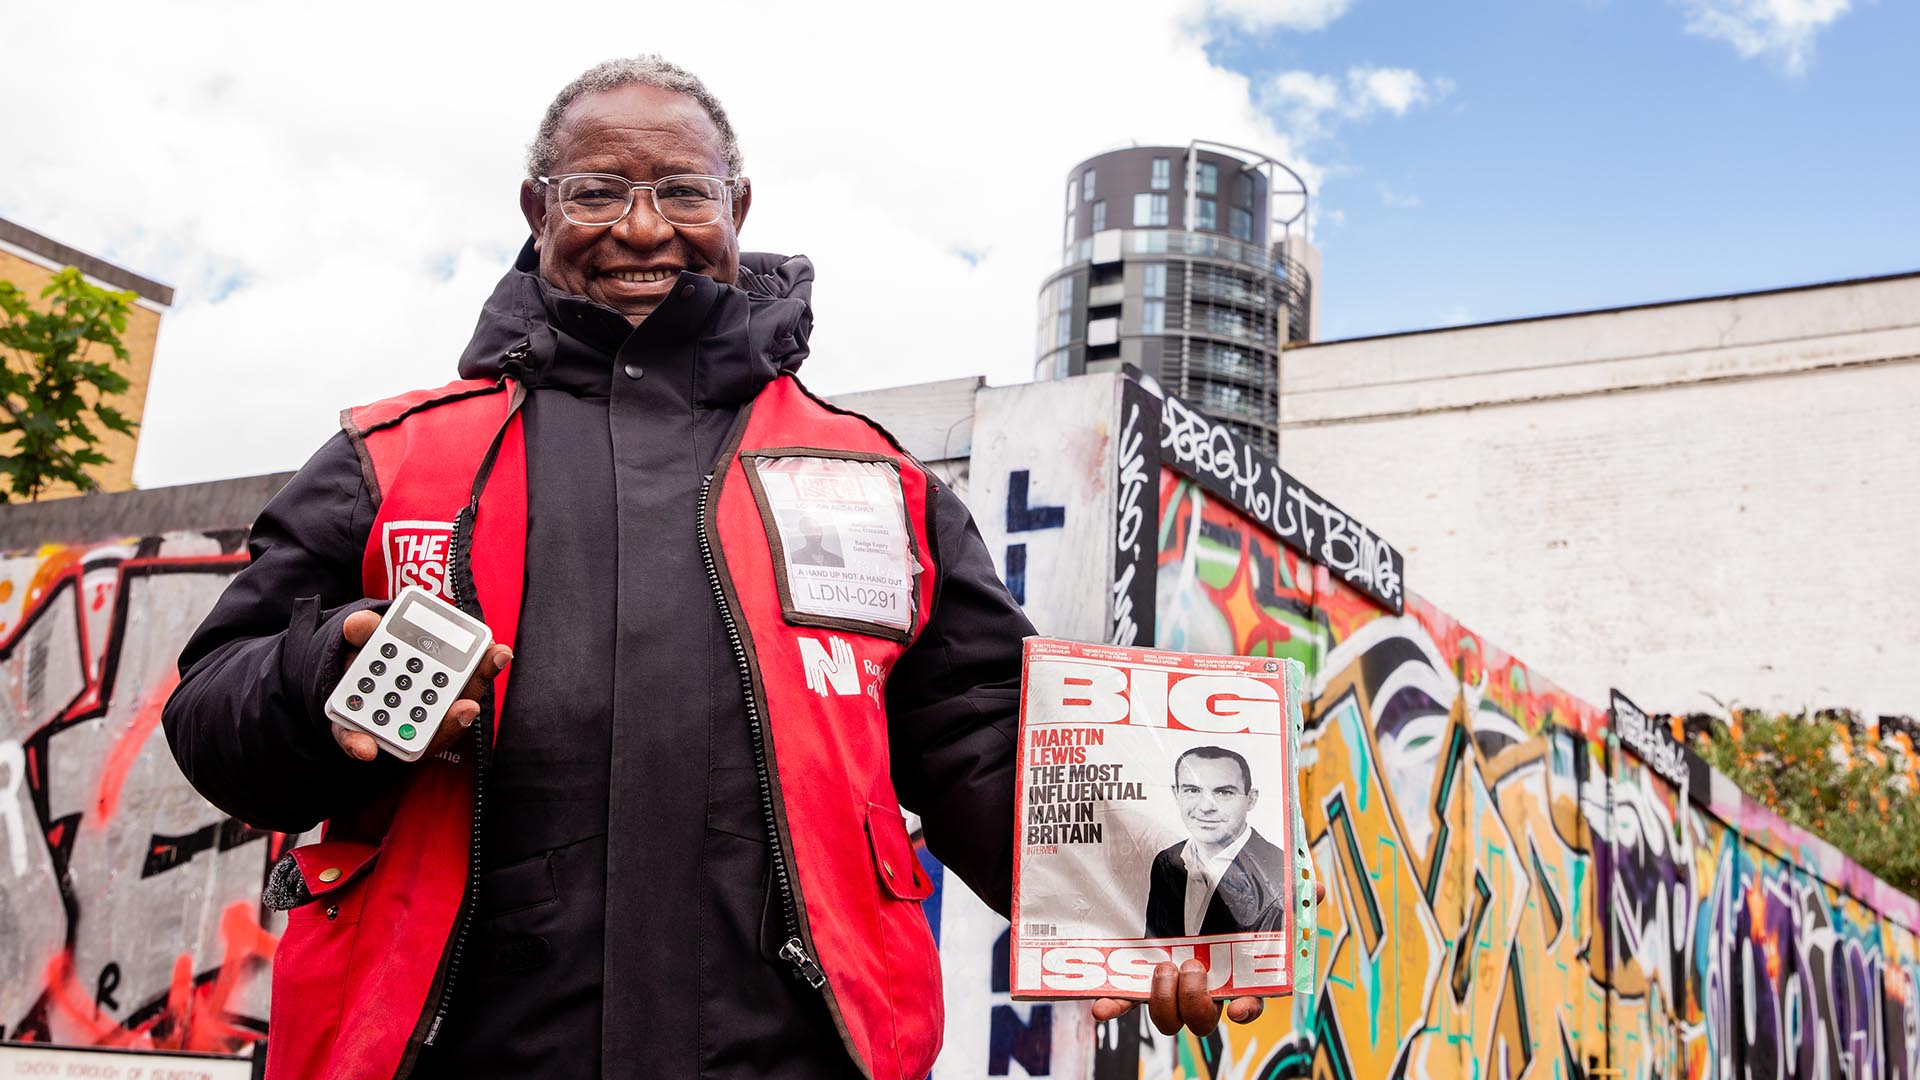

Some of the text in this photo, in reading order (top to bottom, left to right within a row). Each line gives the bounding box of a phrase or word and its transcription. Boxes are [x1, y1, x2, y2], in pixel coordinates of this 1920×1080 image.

[394, 535, 448, 563] THE
[395, 560, 457, 600] ISSU
[798, 568, 805, 576] A
[829, 571, 840, 579] UP
[842, 572, 857, 580] NOT
[866, 575, 887, 584] HAND
[888, 578, 903, 586] OUT
[807, 582, 897, 610] LDN-0291
[1264, 662, 1278, 672] £3
[1026, 662, 1280, 734] BIG
[1030, 728, 1104, 748] MARTIN
[1030, 747, 1087, 767] LEWIS
[1029, 764, 1123, 786] THE MOST
[1028, 782, 1147, 806] INFLUENTIAL
[1028, 802, 1094, 825] MAN IN
[1027, 823, 1103, 846] BRITAIN
[1026, 844, 1059, 855] INTERVIEW
[1018, 942, 1287, 992] ISSUE
